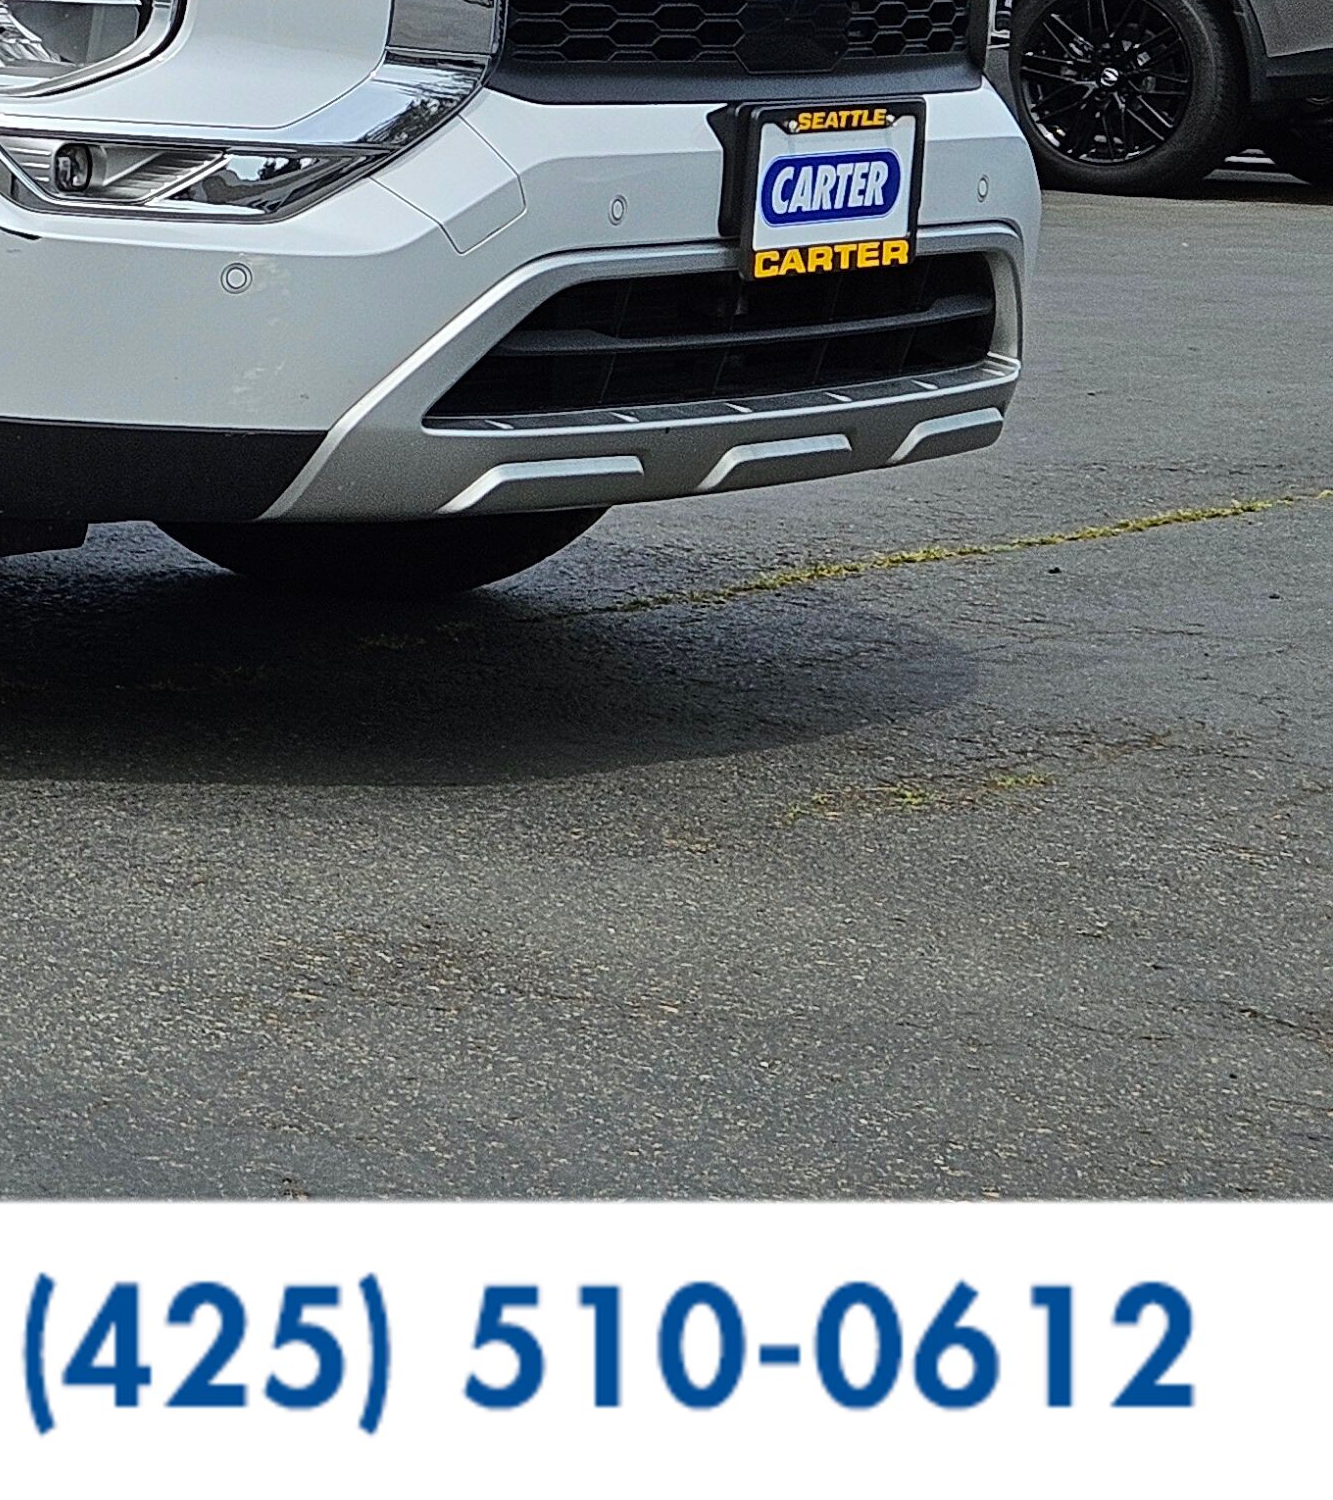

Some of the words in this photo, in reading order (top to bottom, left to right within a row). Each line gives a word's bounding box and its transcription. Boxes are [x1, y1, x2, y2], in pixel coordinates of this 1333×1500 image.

[797, 108, 887, 131] SEATTLE
[771, 160, 889, 215] CARTER
[754, 239, 910, 279] CARTER
